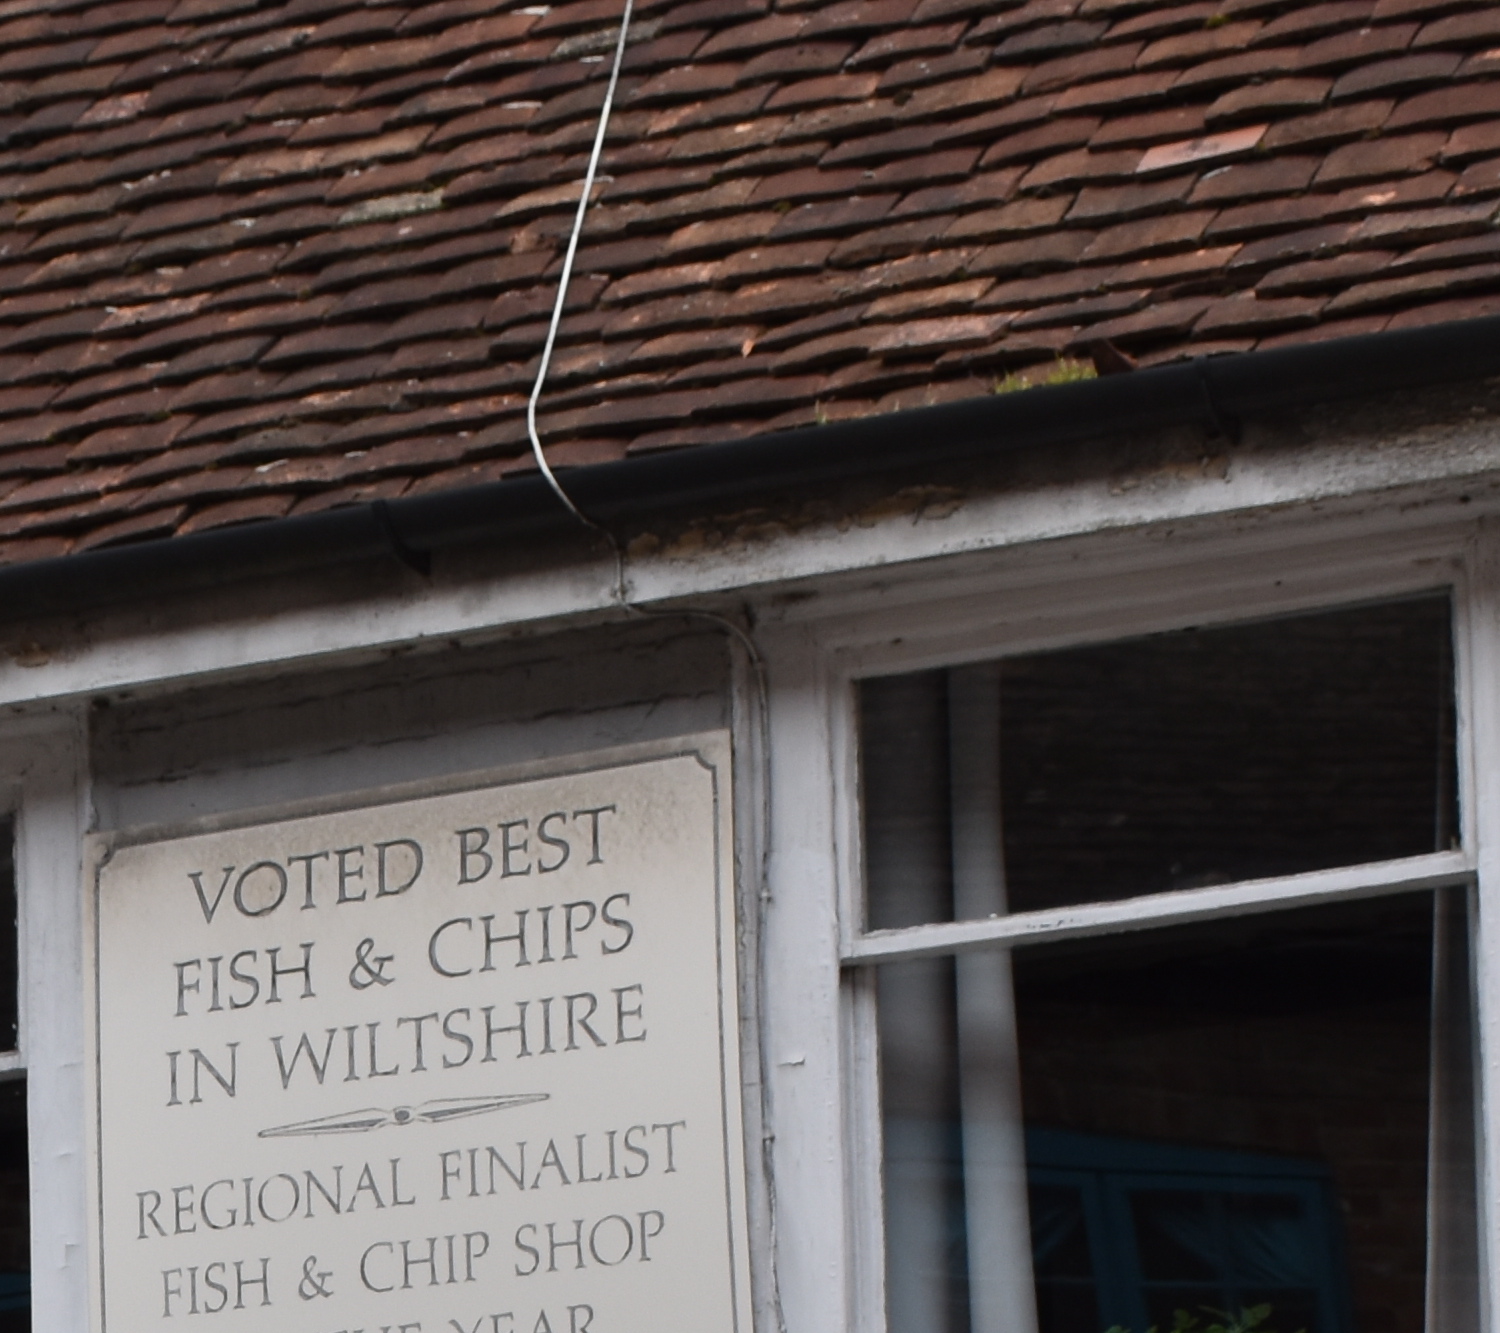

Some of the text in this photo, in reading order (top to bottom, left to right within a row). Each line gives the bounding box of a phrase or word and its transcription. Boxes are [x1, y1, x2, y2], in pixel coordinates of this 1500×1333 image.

[189, 805, 616, 923] VOTED BEST
[173, 893, 634, 1017] FISH & CHIPS
[166, 984, 649, 1106] IN WILTSHIRE
[136, 1121, 687, 1240] REGIONAL FINALIST
[161, 1209, 666, 1319] FISH & CHIP SHOP
